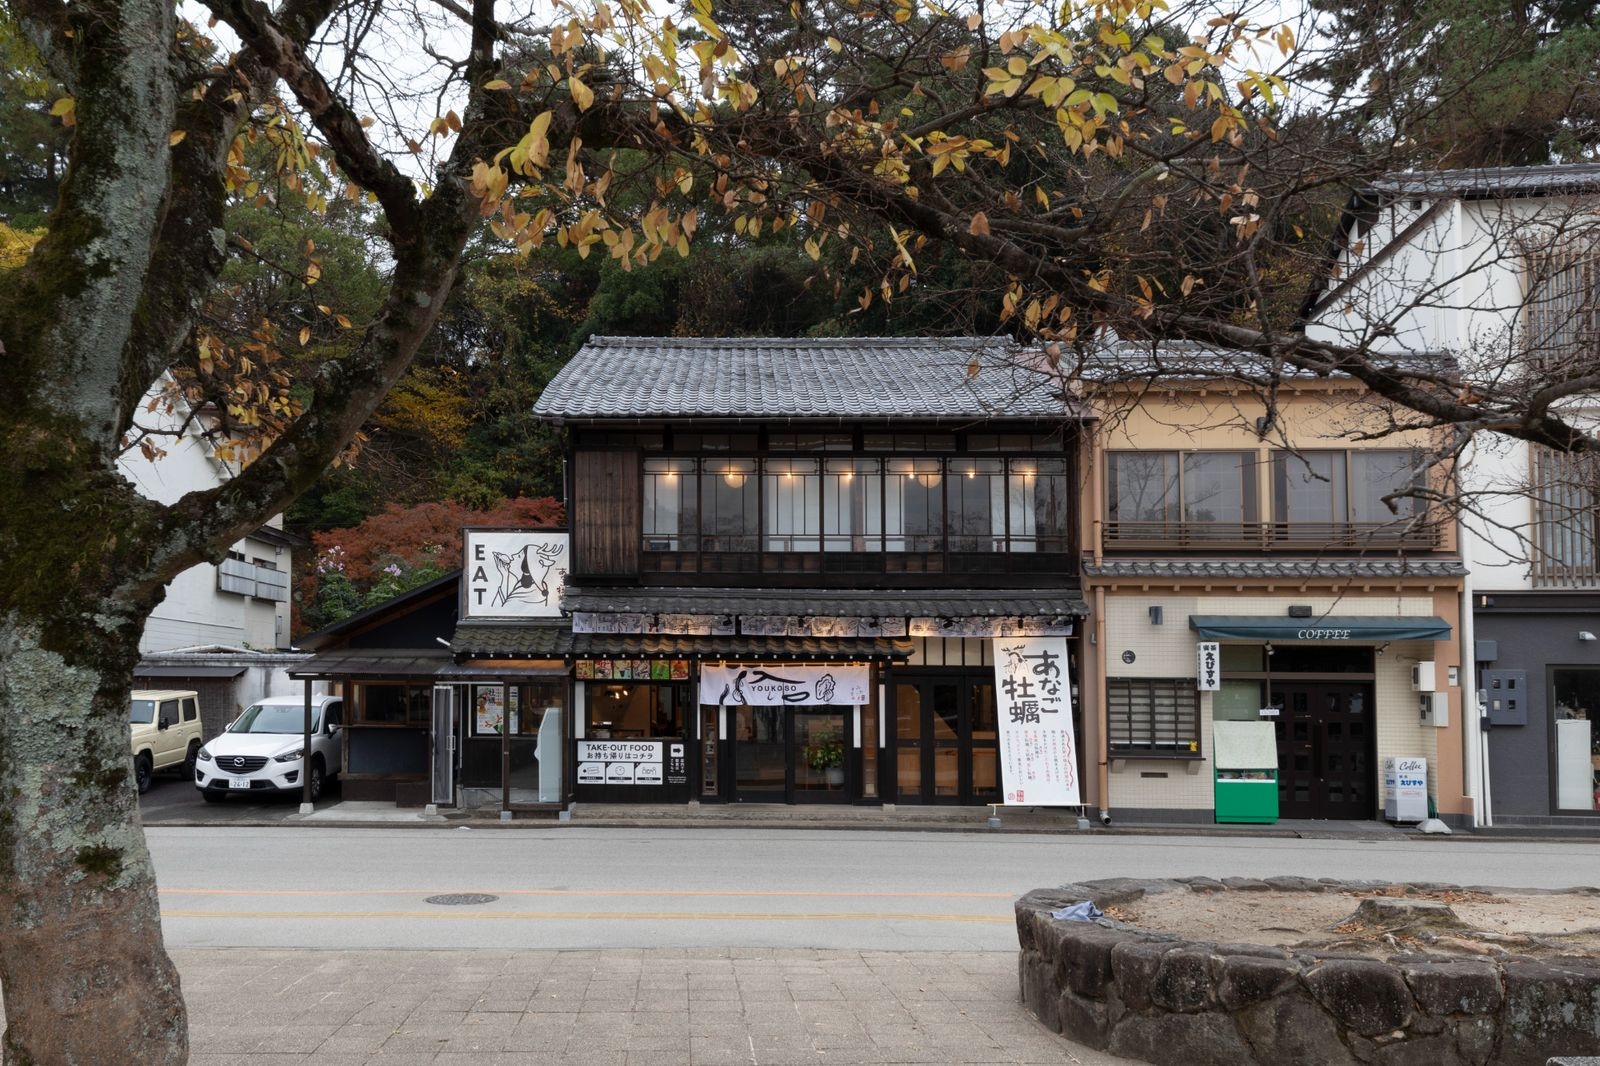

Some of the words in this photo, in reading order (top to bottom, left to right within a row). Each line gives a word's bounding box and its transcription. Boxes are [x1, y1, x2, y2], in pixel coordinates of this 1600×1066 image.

[472, 544, 488, 605] EAT
[1298, 629, 1351, 640] COFFEE
[1022, 650, 1061, 713] あなご
[1205, 652, 1216, 688] えびすや
[1001, 674, 1040, 725] 牡蠣
[587, 752, 653, 760] お持ち帰りはコチラ
[629, 744, 654, 752] FOOD
[1399, 760, 1422, 771] Coffee
